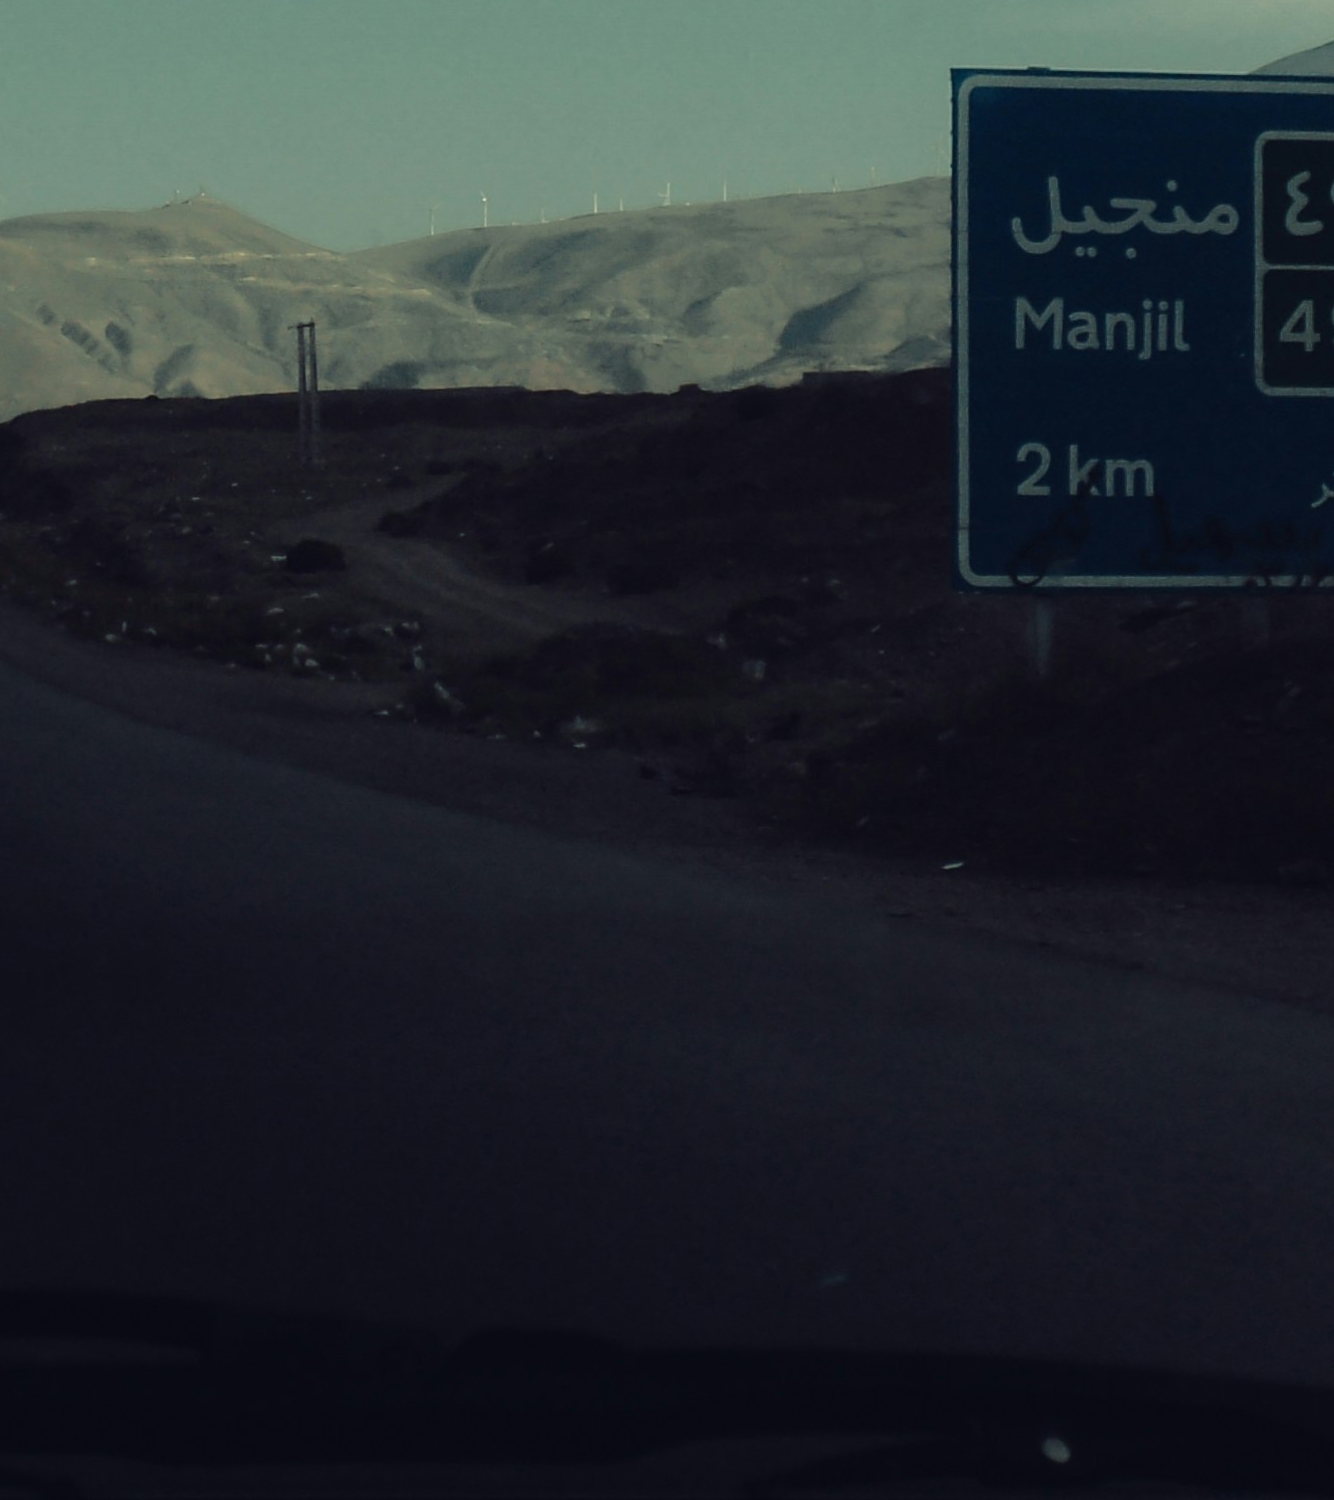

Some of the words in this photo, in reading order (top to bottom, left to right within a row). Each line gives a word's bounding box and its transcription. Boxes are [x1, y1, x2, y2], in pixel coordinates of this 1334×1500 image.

[1010, 175, 1240, 260] منجیل
[1014, 296, 1191, 361] Manjil
[1016, 441, 1053, 496] 2
[1068, 443, 1155, 498] km
